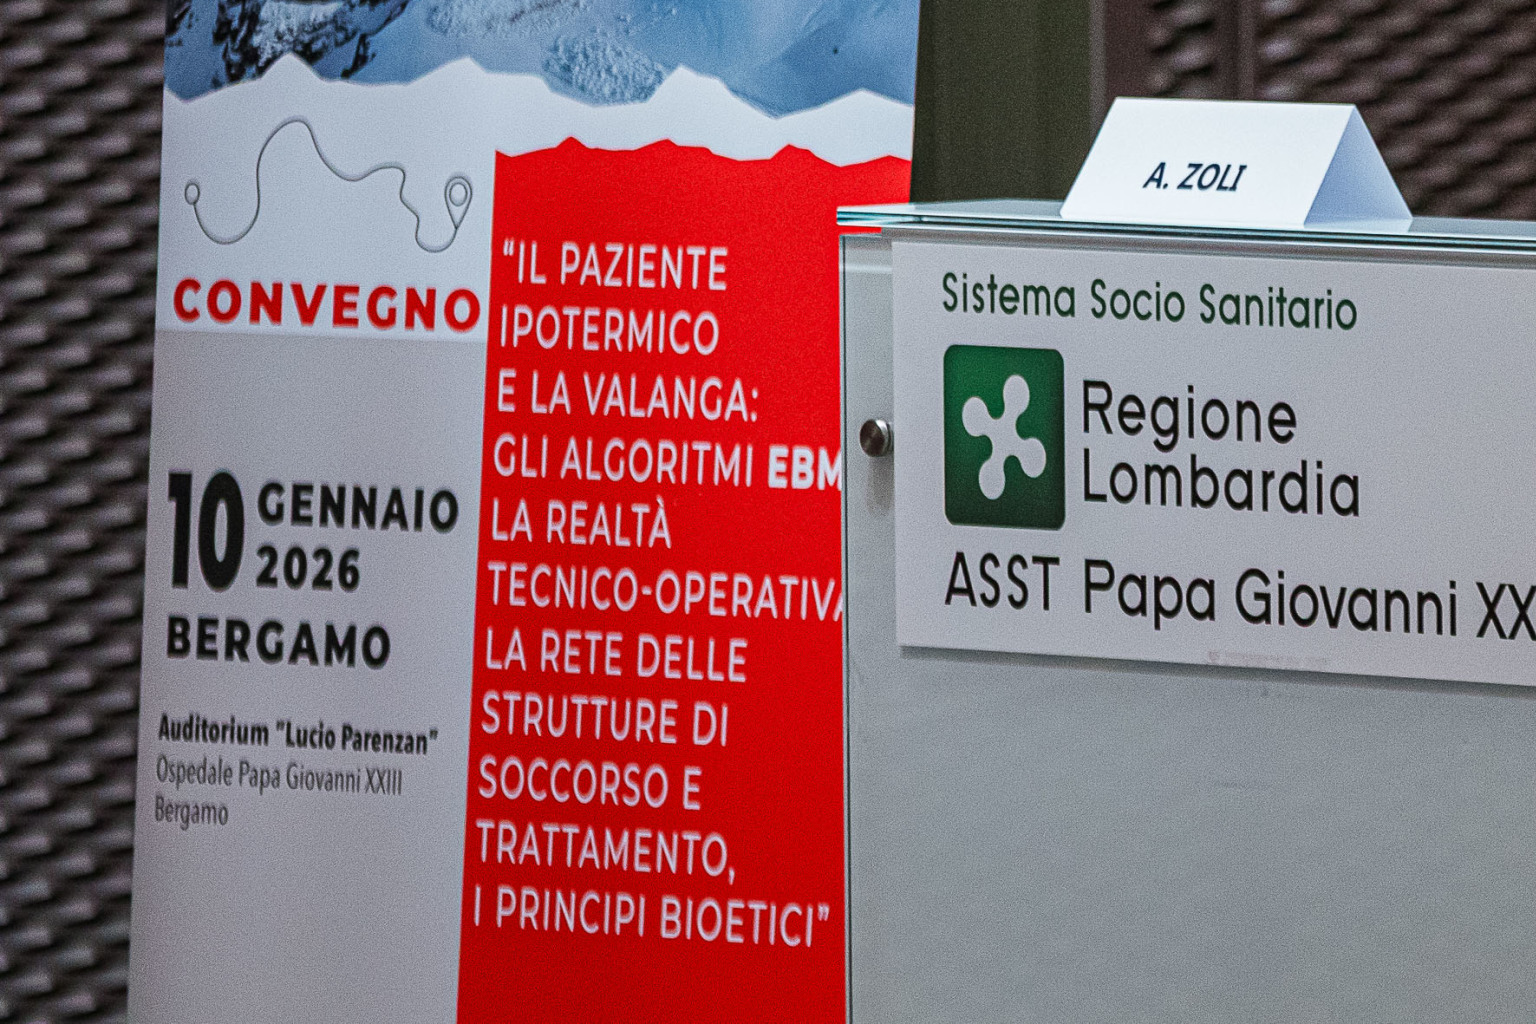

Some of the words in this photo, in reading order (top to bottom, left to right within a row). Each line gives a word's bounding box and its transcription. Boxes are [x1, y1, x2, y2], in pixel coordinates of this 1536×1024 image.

[1142, 161, 1169, 190] A.
[1176, 162, 1248, 192] ZOLI
[560, 241, 729, 291] PAZIENTE
[173, 277, 481, 333] CONVEGNO
[942, 271, 1076, 318] Sistema
[1090, 278, 1186, 323] Socio
[1199, 283, 1358, 331] Sanitario
[500, 304, 720, 356] IPOTERMICO
[497, 368, 517, 413] E
[531, 370, 571, 415] LA
[583, 372, 759, 423] VALANGA:
[1082, 379, 1297, 453] Regione
[493, 432, 549, 478] GLI
[560, 436, 754, 488] ALGORITMI
[1083, 447, 1359, 517] Lombardia
[167, 470, 245, 592] 10
[257, 481, 459, 533] GENNAIO
[491, 498, 533, 542] LA
[546, 495, 672, 549] REALTÀ
[255, 543, 360, 592] 2026
[944, 551, 1060, 611] ASST
[1084, 558, 1216, 631] Papa
[1235, 567, 1457, 637] Giovanni
[166, 614, 391, 669] BERGAMO
[485, 627, 527, 671] LA
[540, 628, 623, 676] RETE
[636, 633, 748, 683] DELLE
[157, 714, 270, 746] Auditorium
[481, 690, 679, 744] STRUTTURE
[692, 701, 729, 747] DI
[155, 752, 234, 791] Ospedale
[238, 758, 281, 796] Papa
[285, 761, 361, 793] Giovanni
[364, 767, 403, 795] XXIII
[478, 755, 669, 809] SOCCORSO
[682, 766, 702, 811] E
[154, 796, 229, 831] Bergamo
[476, 819, 736, 885] TRATTAMENTO,
[474, 885, 482, 926] I
[496, 885, 646, 937] PRINCIPI
